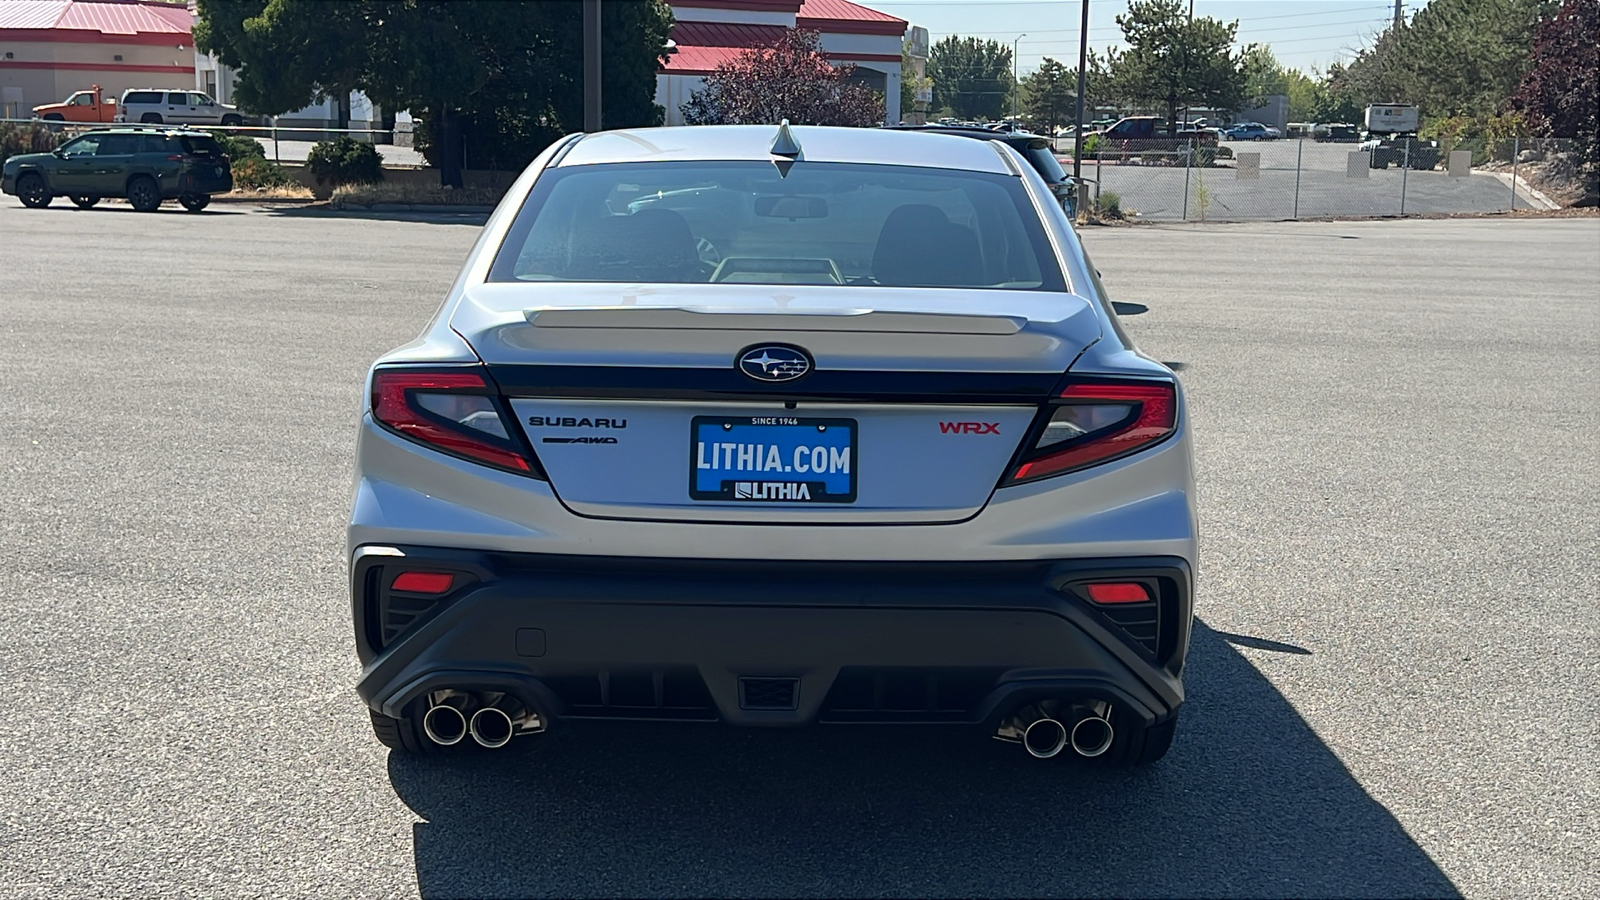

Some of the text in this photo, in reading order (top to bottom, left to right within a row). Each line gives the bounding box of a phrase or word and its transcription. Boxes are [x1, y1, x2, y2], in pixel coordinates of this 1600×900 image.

[528, 416, 627, 429] SUBARU
[938, 421, 1001, 435] WRX
[697, 442, 850, 474] LITHIA.COM
[752, 482, 811, 500] LITHIA
